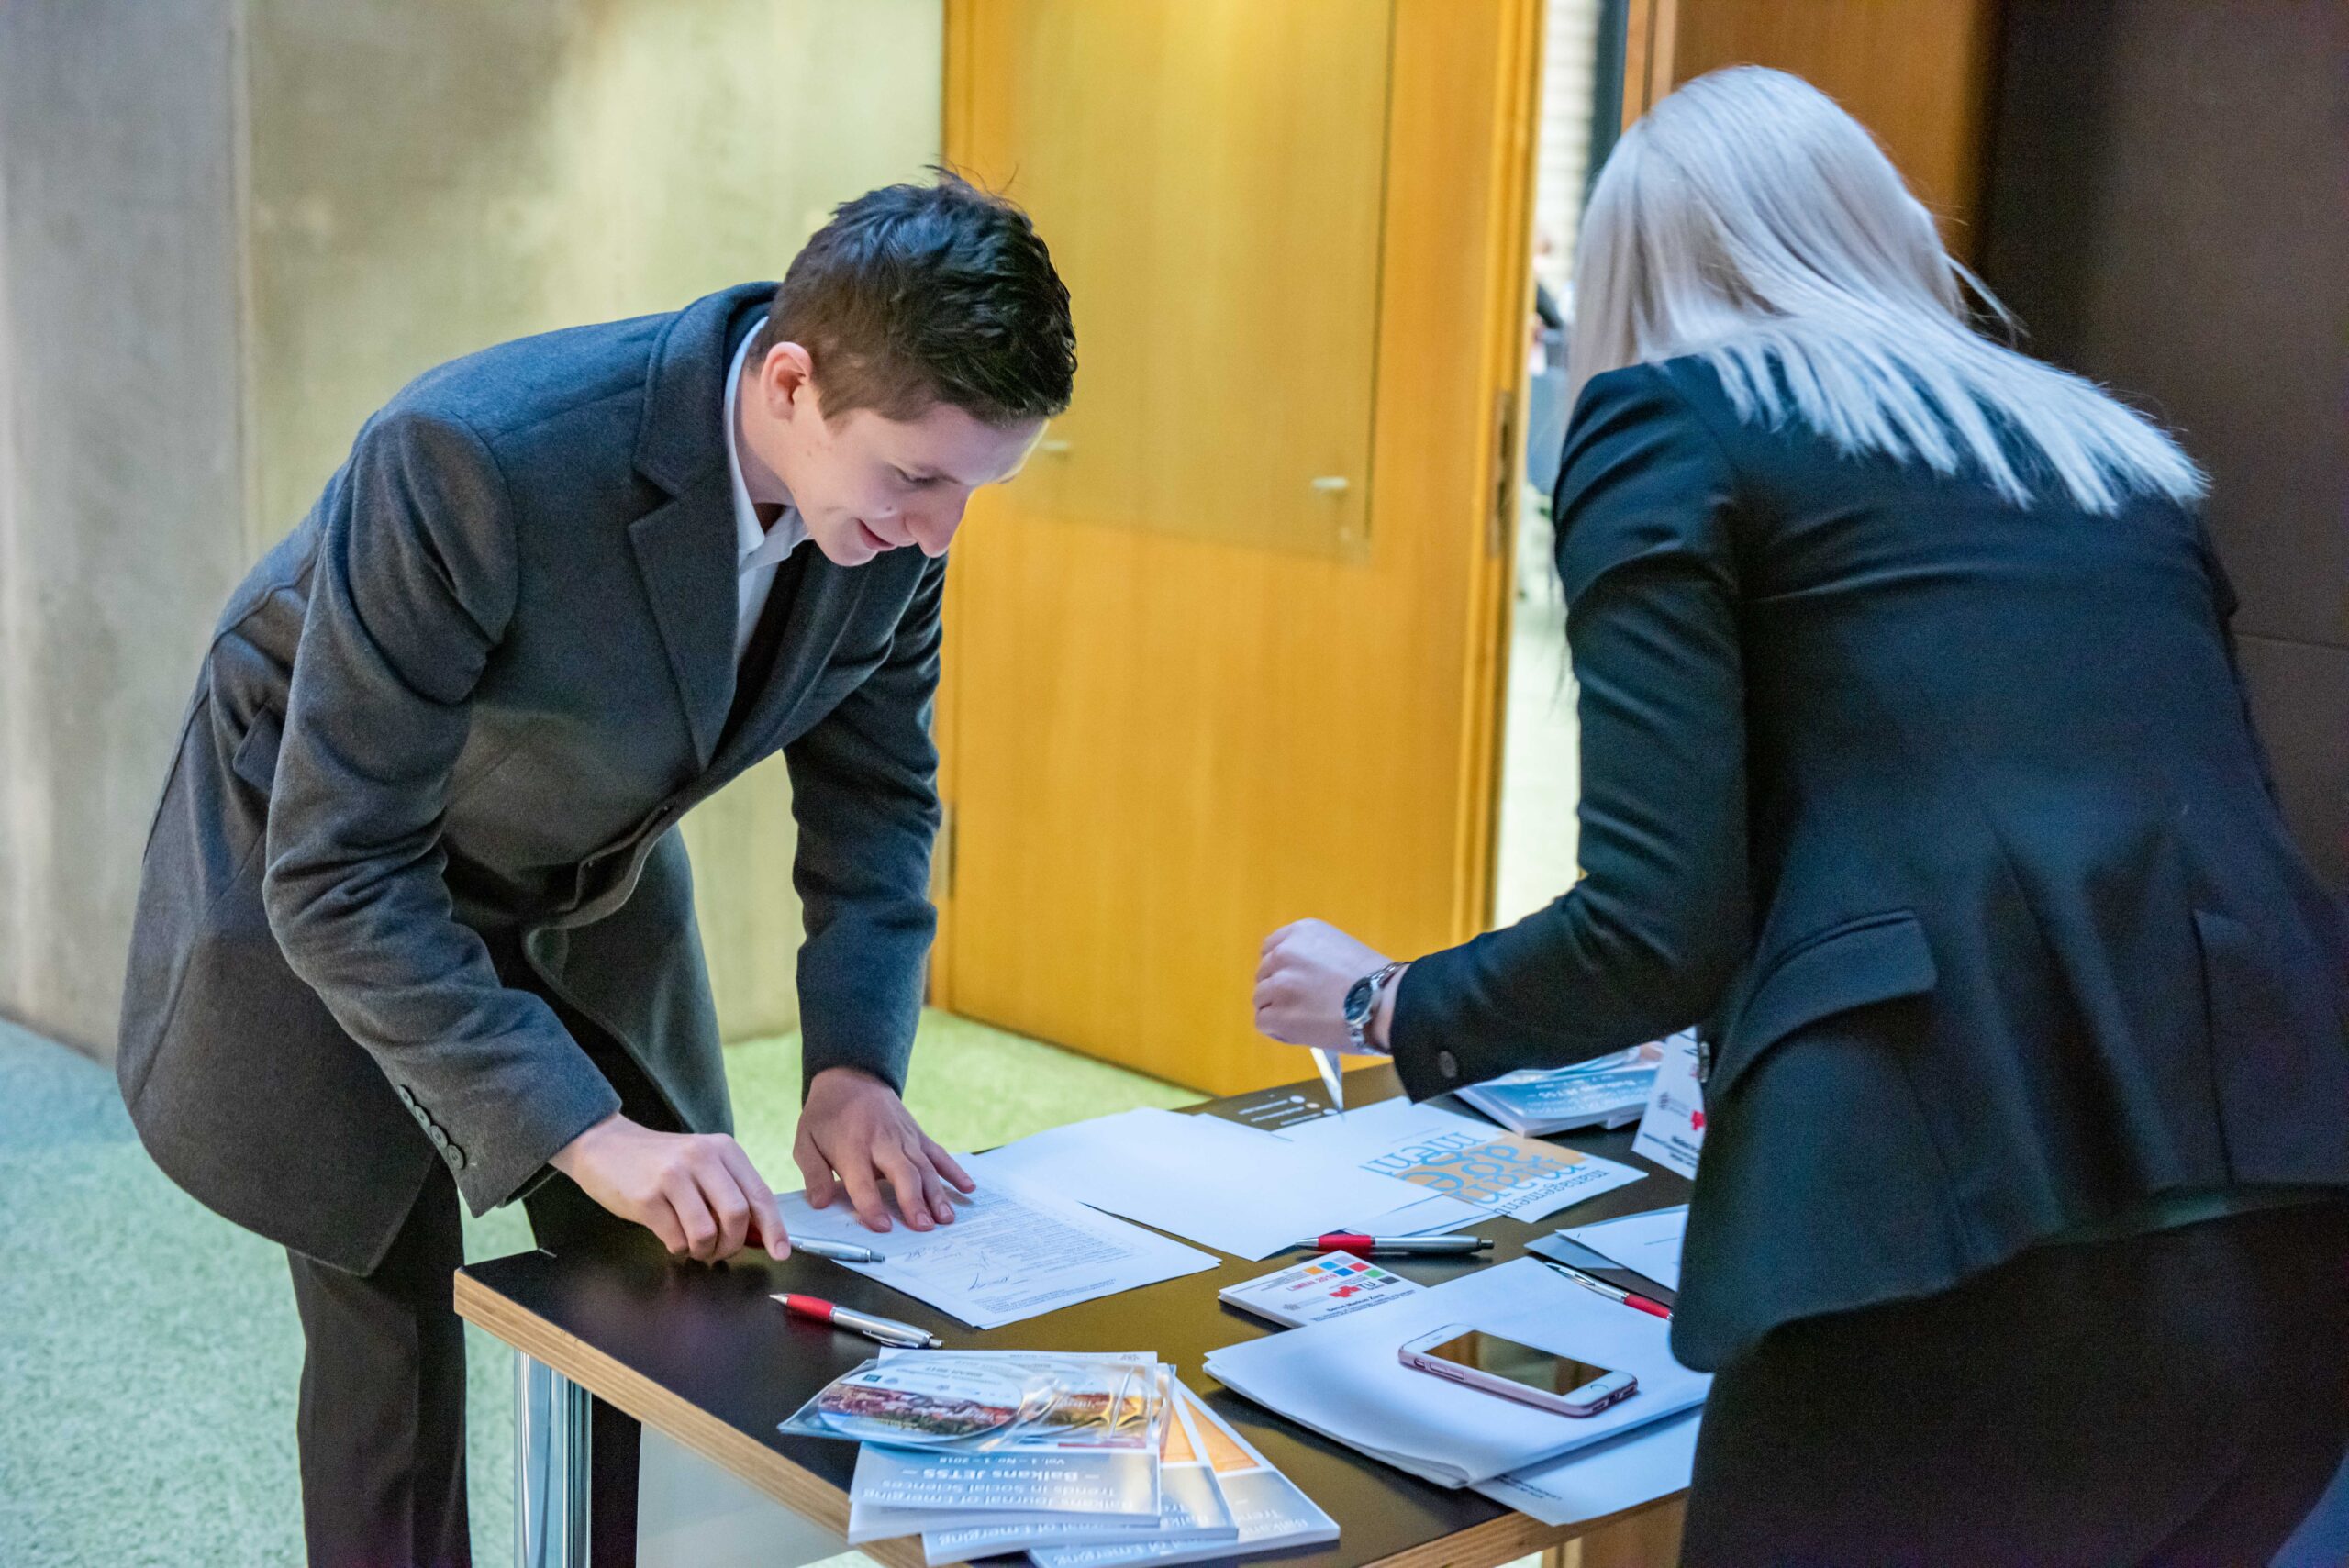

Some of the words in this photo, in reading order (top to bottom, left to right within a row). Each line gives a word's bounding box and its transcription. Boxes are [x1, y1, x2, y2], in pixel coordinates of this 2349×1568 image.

[1493, 1168, 1611, 1216] management
[923, 1468, 986, 1481] JETSS
[992, 1470, 1079, 1483] Balkans
[881, 1479, 963, 1494] Sciences
[968, 1483, 1025, 1496] Social
[1030, 1485, 1048, 1495] in
[1053, 1485, 1115, 1496] Trends
[863, 1487, 954, 1504] Emerging
[961, 1494, 980, 1505] of
[985, 1495, 1053, 1507] Journal
[1061, 1496, 1133, 1510] Balkans
